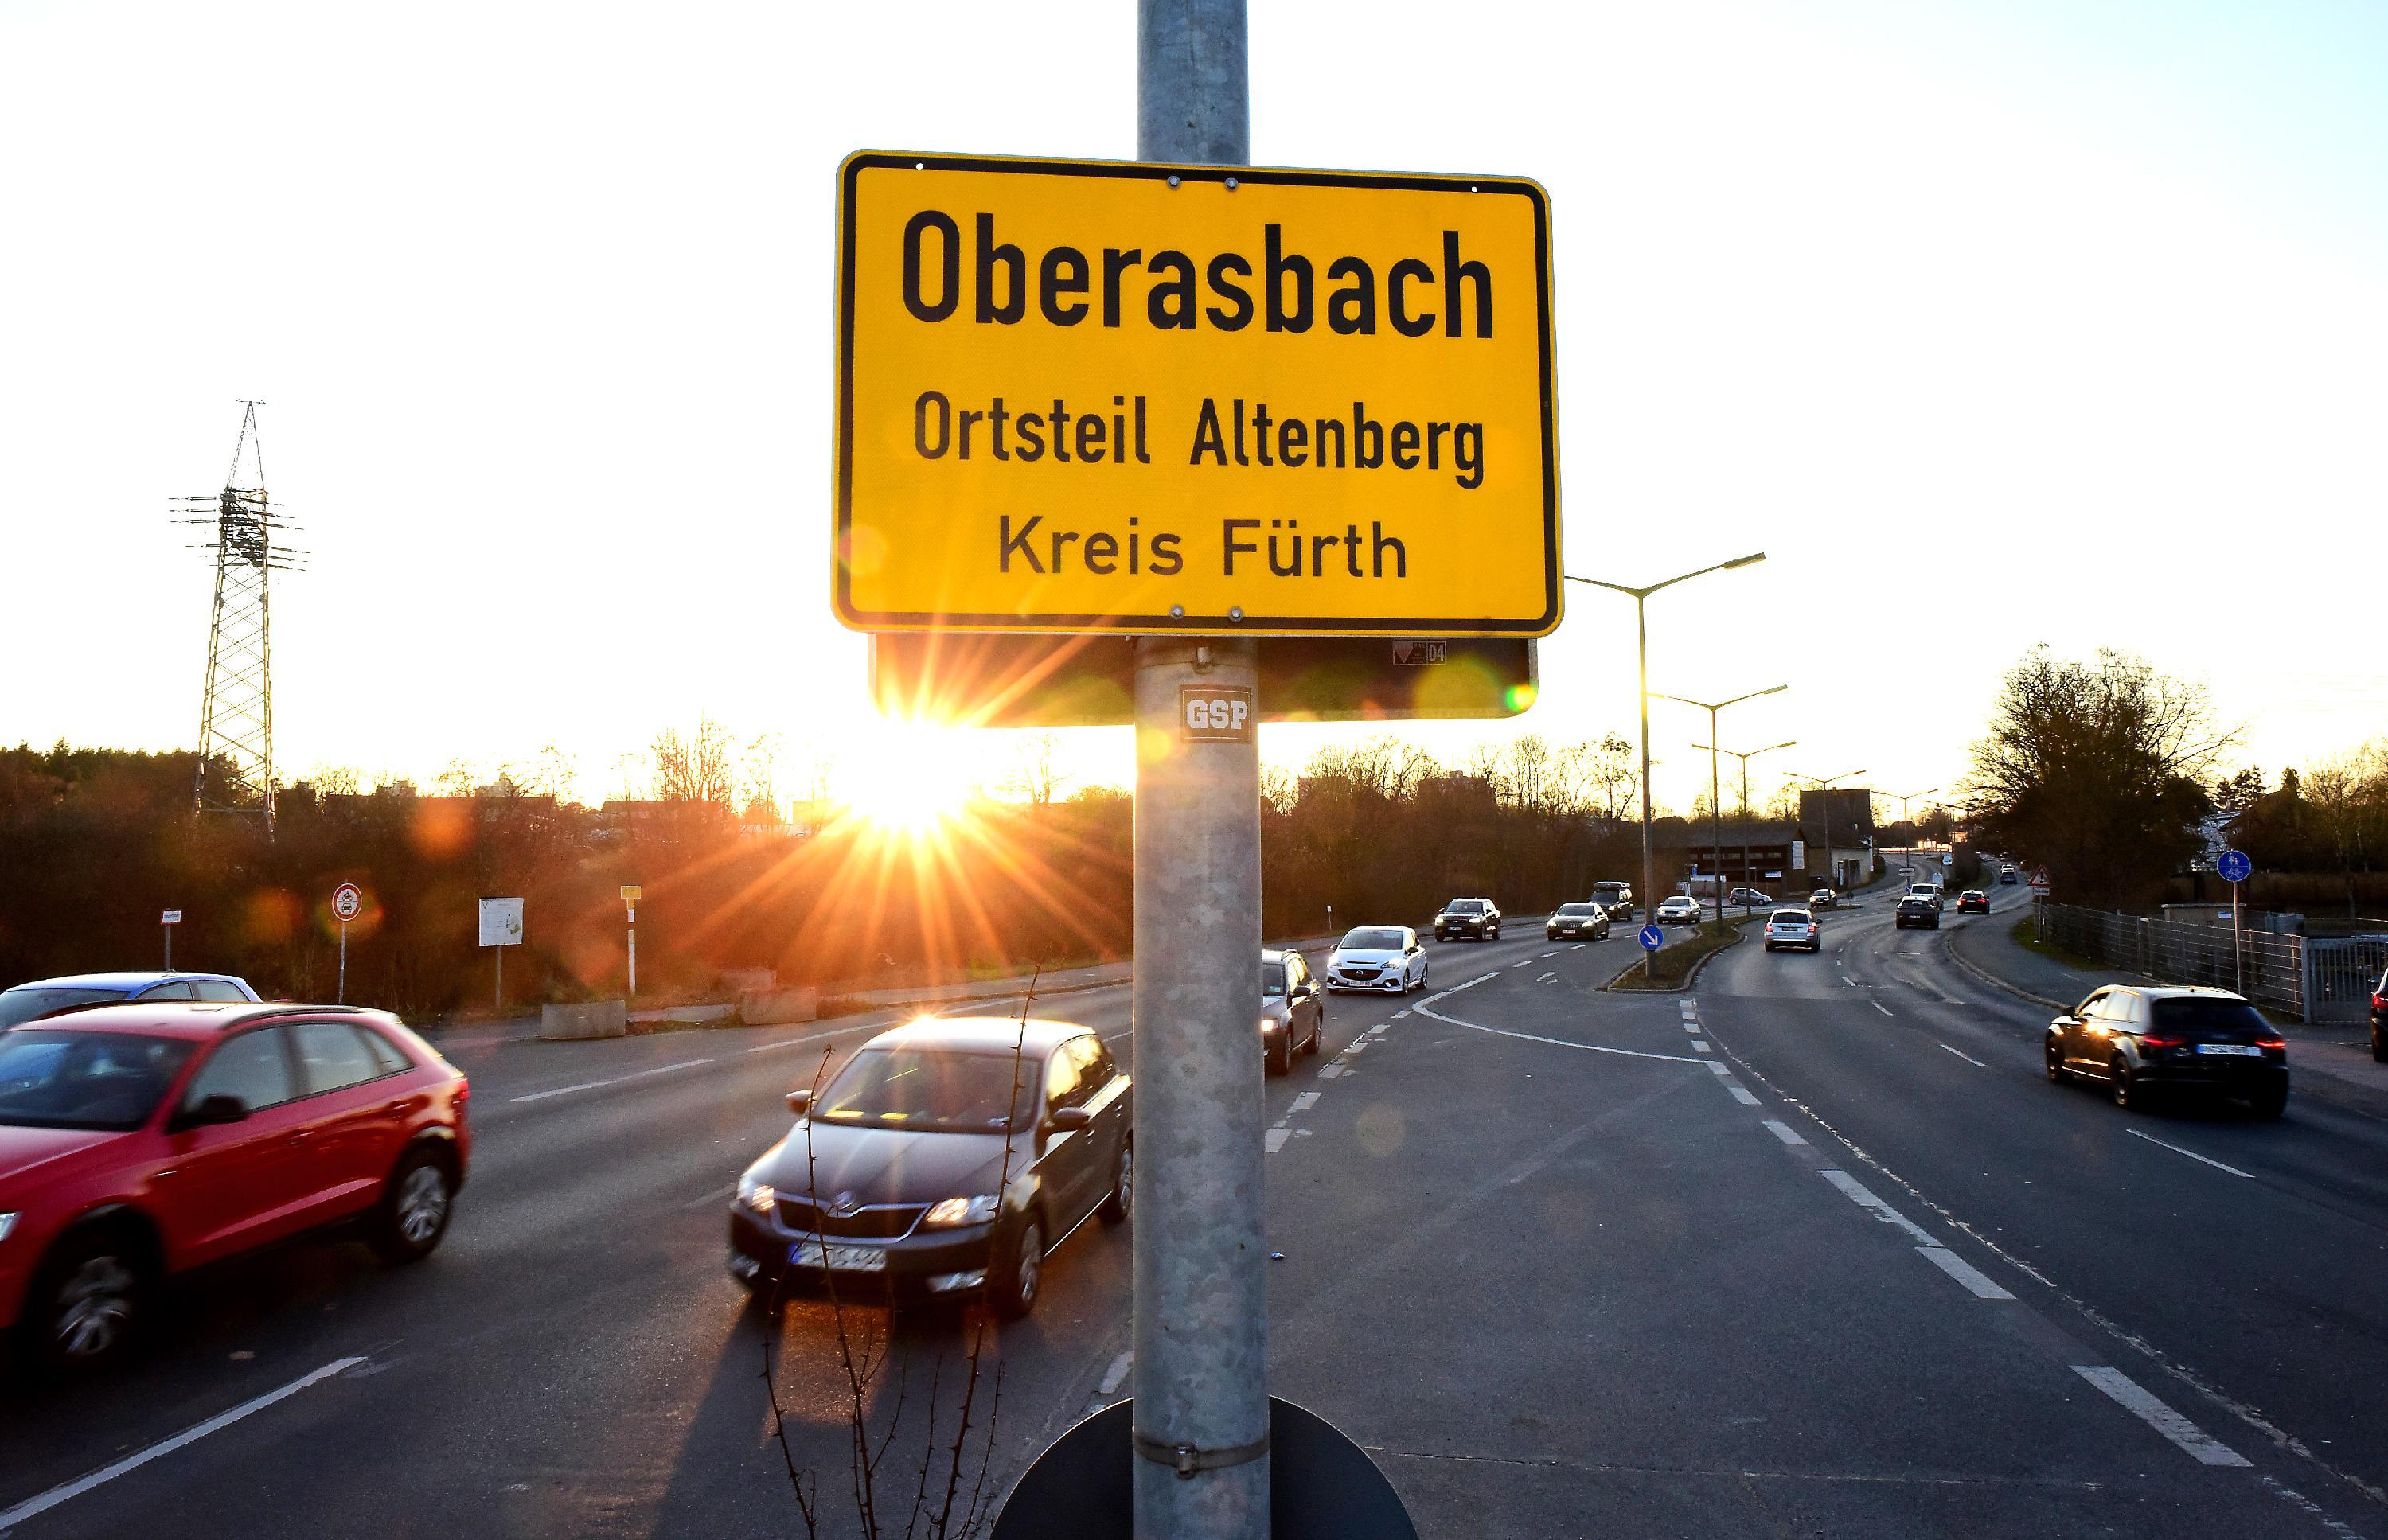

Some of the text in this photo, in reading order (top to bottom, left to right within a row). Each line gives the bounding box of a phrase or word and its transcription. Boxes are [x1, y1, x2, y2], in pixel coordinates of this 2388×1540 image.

[903, 209, 1494, 339] Oberasbach
[915, 390, 1485, 490] Ortsteil Altenberg
[998, 514, 1407, 578] Kreis Fürth
[1428, 643, 1445, 661] 04
[1187, 699, 1248, 730] GSP
